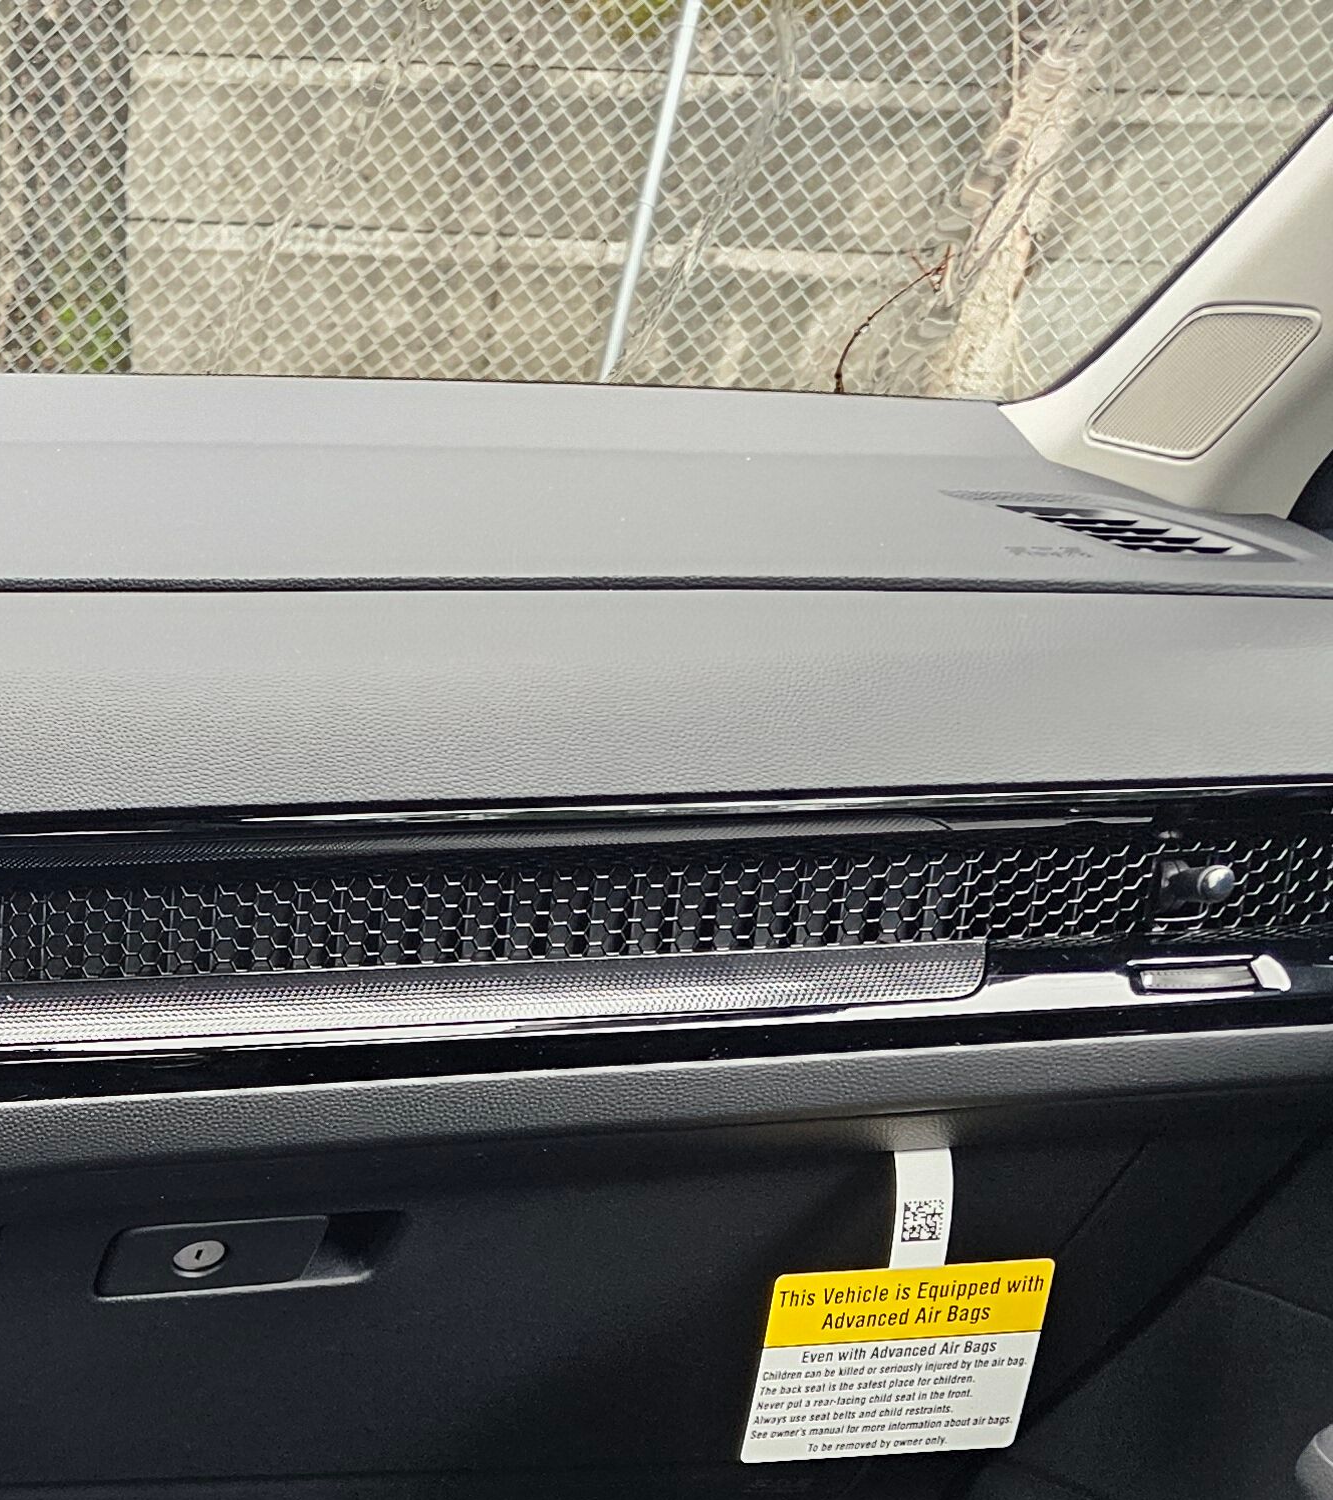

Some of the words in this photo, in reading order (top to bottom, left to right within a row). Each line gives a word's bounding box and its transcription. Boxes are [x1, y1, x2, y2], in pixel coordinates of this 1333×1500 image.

[779, 1289, 816, 1308] This
[824, 1285, 889, 1305] Vehicle
[895, 1283, 911, 1300] is
[917, 1277, 1001, 1302] Equipped
[1007, 1275, 1044, 1293] with
[821, 1308, 910, 1330] Advanced
[915, 1306, 941, 1324] Air
[947, 1305, 991, 1325] Bags
[801, 1350, 834, 1364] Even
[838, 1347, 866, 1361] with
[870, 1343, 936, 1360] Advanced
[939, 1341, 961, 1355] Air
[963, 1340, 998, 1356] Bags
[762, 1369, 802, 1381] Children
[804, 1370, 821, 1379] can
[825, 1367, 835, 1377] be
[838, 1364, 865, 1376] killed
[867, 1366, 877, 1374] or
[879, 1362, 922, 1374] seriously
[925, 1358, 958, 1372] injured
[960, 1360, 971, 1370] by
[974, 1357, 989, 1368] the
[991, 1356, 1005, 1367] air
[1007, 1356, 1027, 1368] bag.
[759, 1385, 777, 1396] The
[780, 1382, 802, 1395] back
[805, 1382, 826, 1393] seat
[828, 1381, 837, 1391] is
[839, 1379, 854, 1391] the
[857, 1378, 886, 1391] safest
[888, 1376, 914, 1390] place
[917, 1375, 931, 1387] for
[933, 1373, 975, 1386] children.
[756, 1400, 784, 1411] Never
[786, 1398, 803, 1410] put
[804, 1399, 811, 1408] a
[813, 1395, 866, 1408] rear-facing
[869, 1392, 892, 1404] child
[895, 1389, 916, 1402] seat
[918, 1390, 927, 1400] in
[930, 1389, 945, 1400] the
[947, 1387, 973, 1399] front.
[753, 1413, 787, 1426] Always
[789, 1413, 807, 1423] use
[809, 1410, 830, 1422] seat
[833, 1408, 856, 1420] belts
[858, 1407, 876, 1418] and
[878, 1406, 902, 1418] child
[905, 1404, 953, 1416] restraints.
[750, 1430, 768, 1440] See
[770, 1426, 806, 1439] owner's
[808, 1425, 844, 1437] manual
[846, 1423, 860, 1435] for
[862, 1423, 886, 1433] more
[887, 1418, 941, 1431] information
[943, 1415, 971, 1428] about
[972, 1415, 984, 1426] air
[987, 1415, 1013, 1427] bags.
[807, 1443, 819, 1452] To
[821, 1441, 833, 1451] be
[835, 1438, 877, 1451] removed
[879, 1437, 891, 1450] by
[893, 1436, 923, 1448] owner
[925, 1434, 947, 1448] only.
